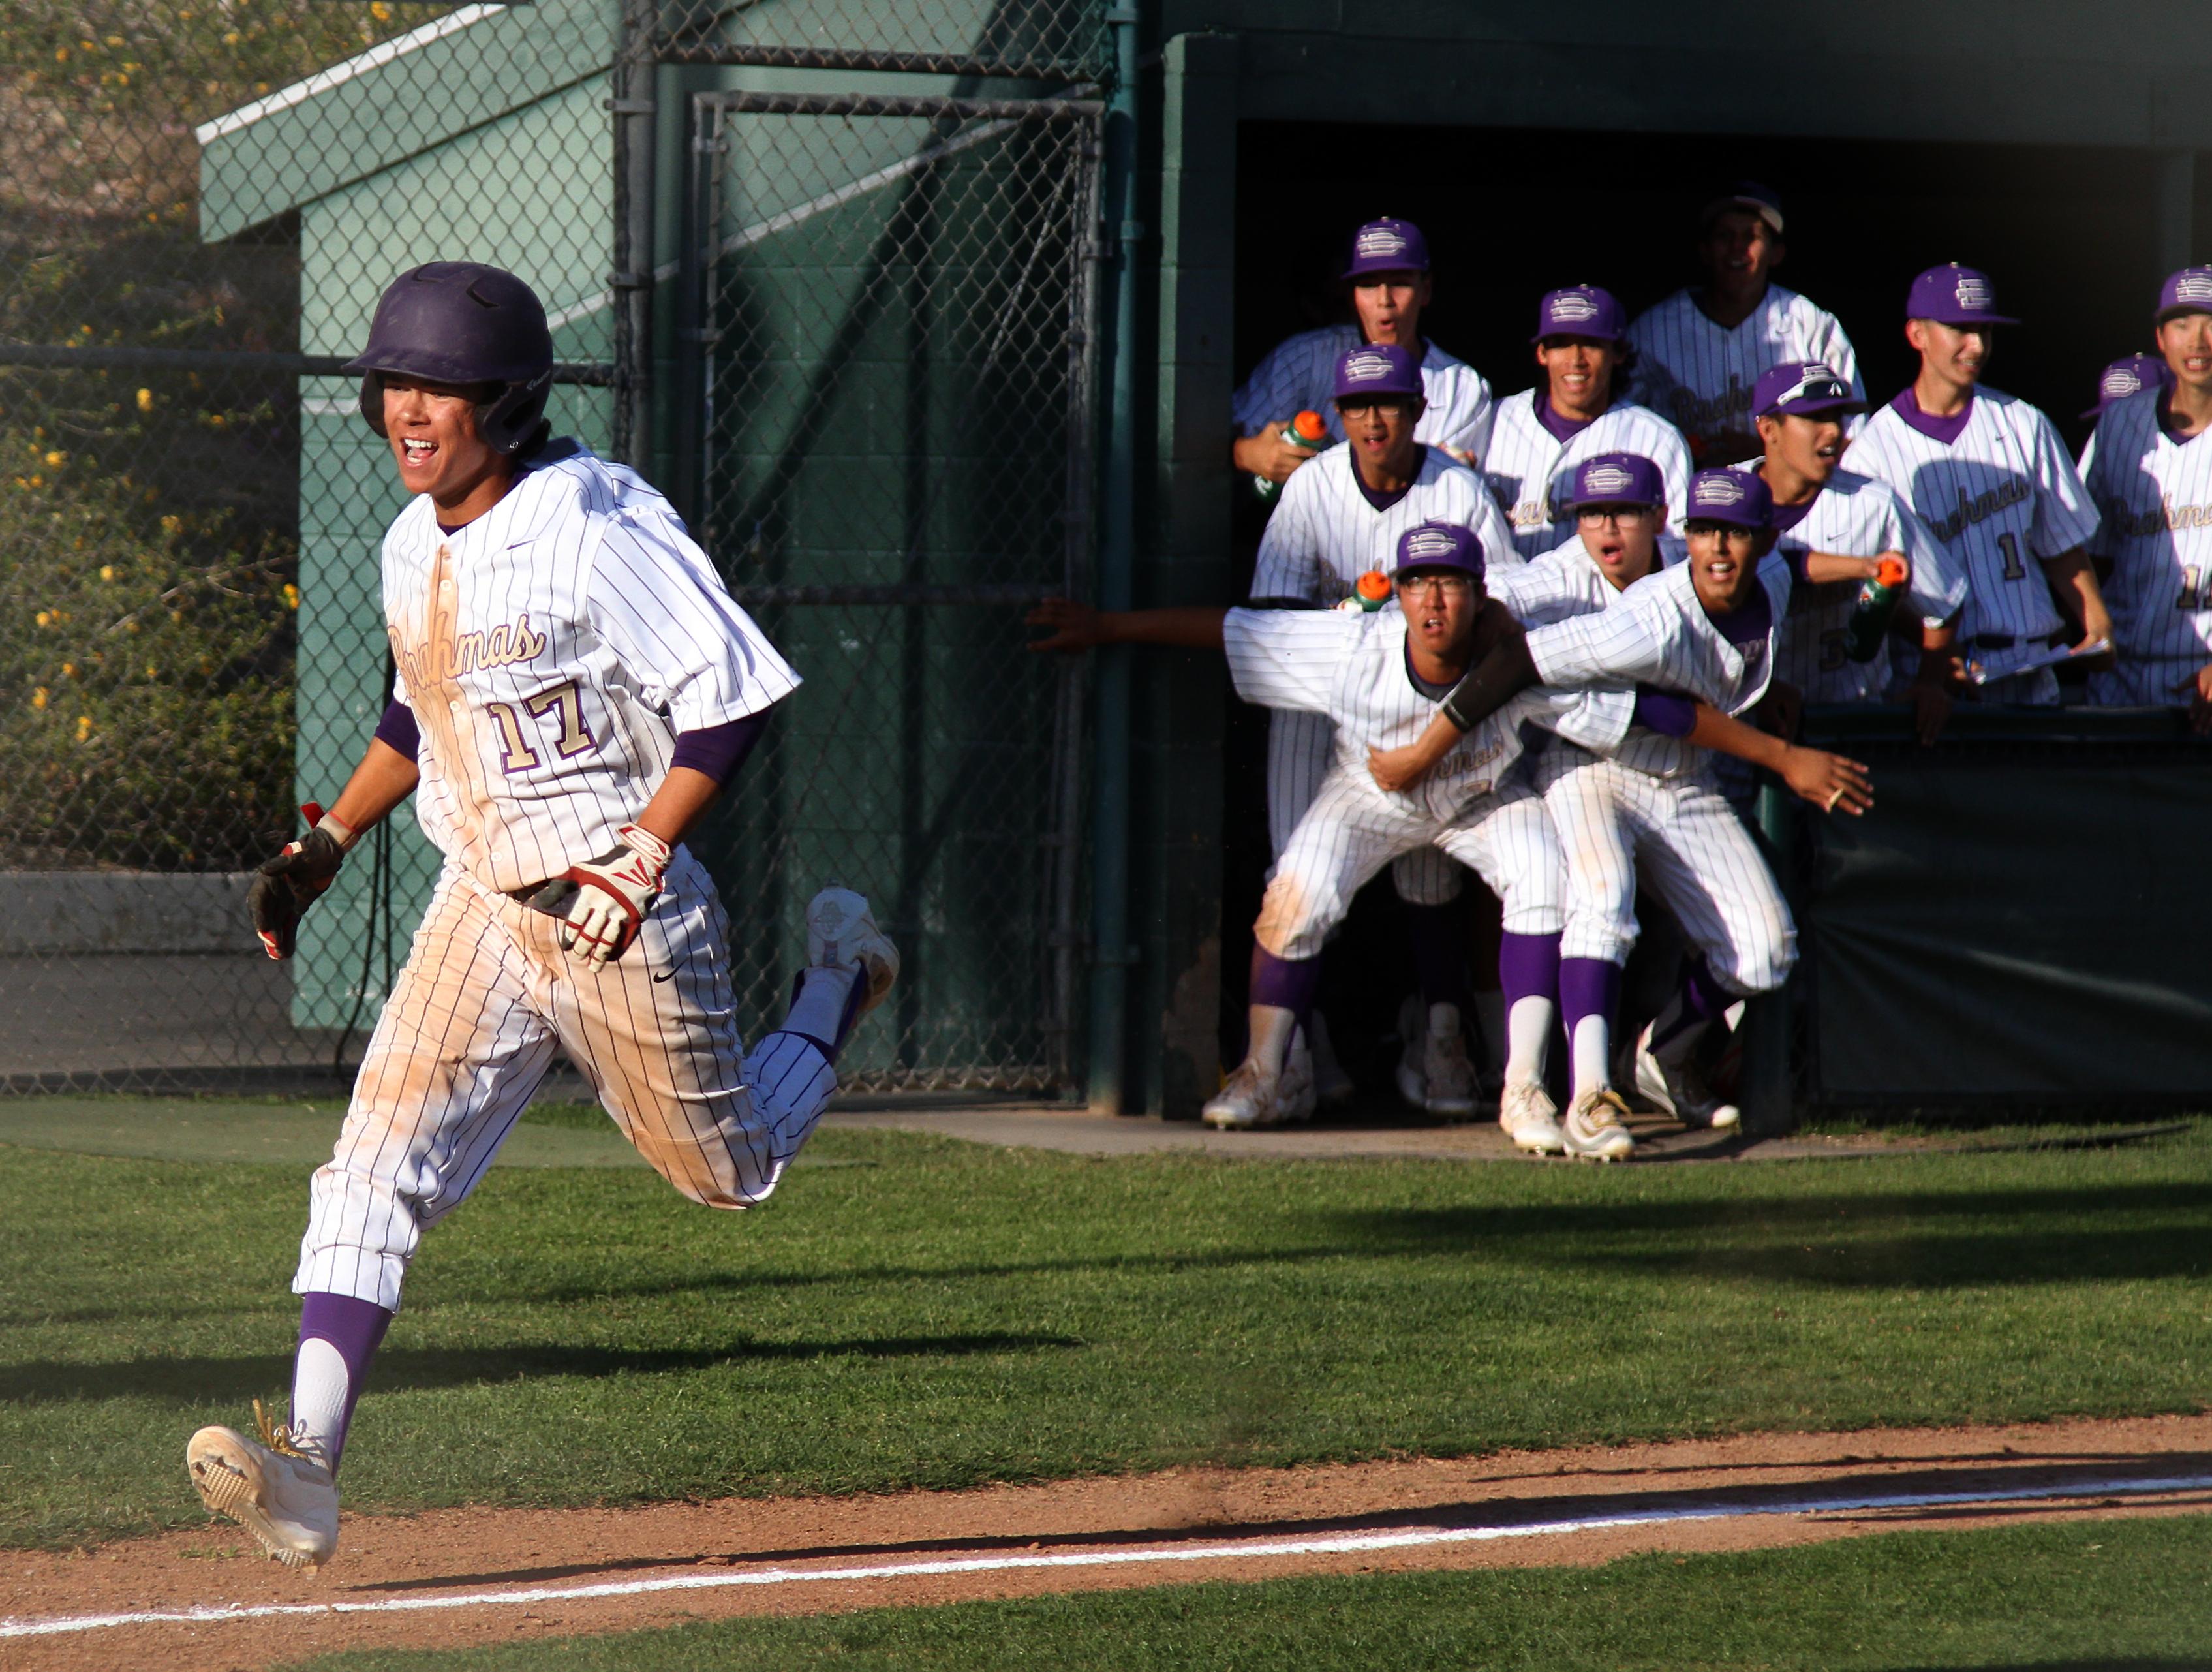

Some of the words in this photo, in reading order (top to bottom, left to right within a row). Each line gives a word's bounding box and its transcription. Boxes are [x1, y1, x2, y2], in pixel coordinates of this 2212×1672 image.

[1997, 529, 2034, 581] 1
[387, 611, 547, 700] Brahmas
[486, 679, 598, 774] 17
